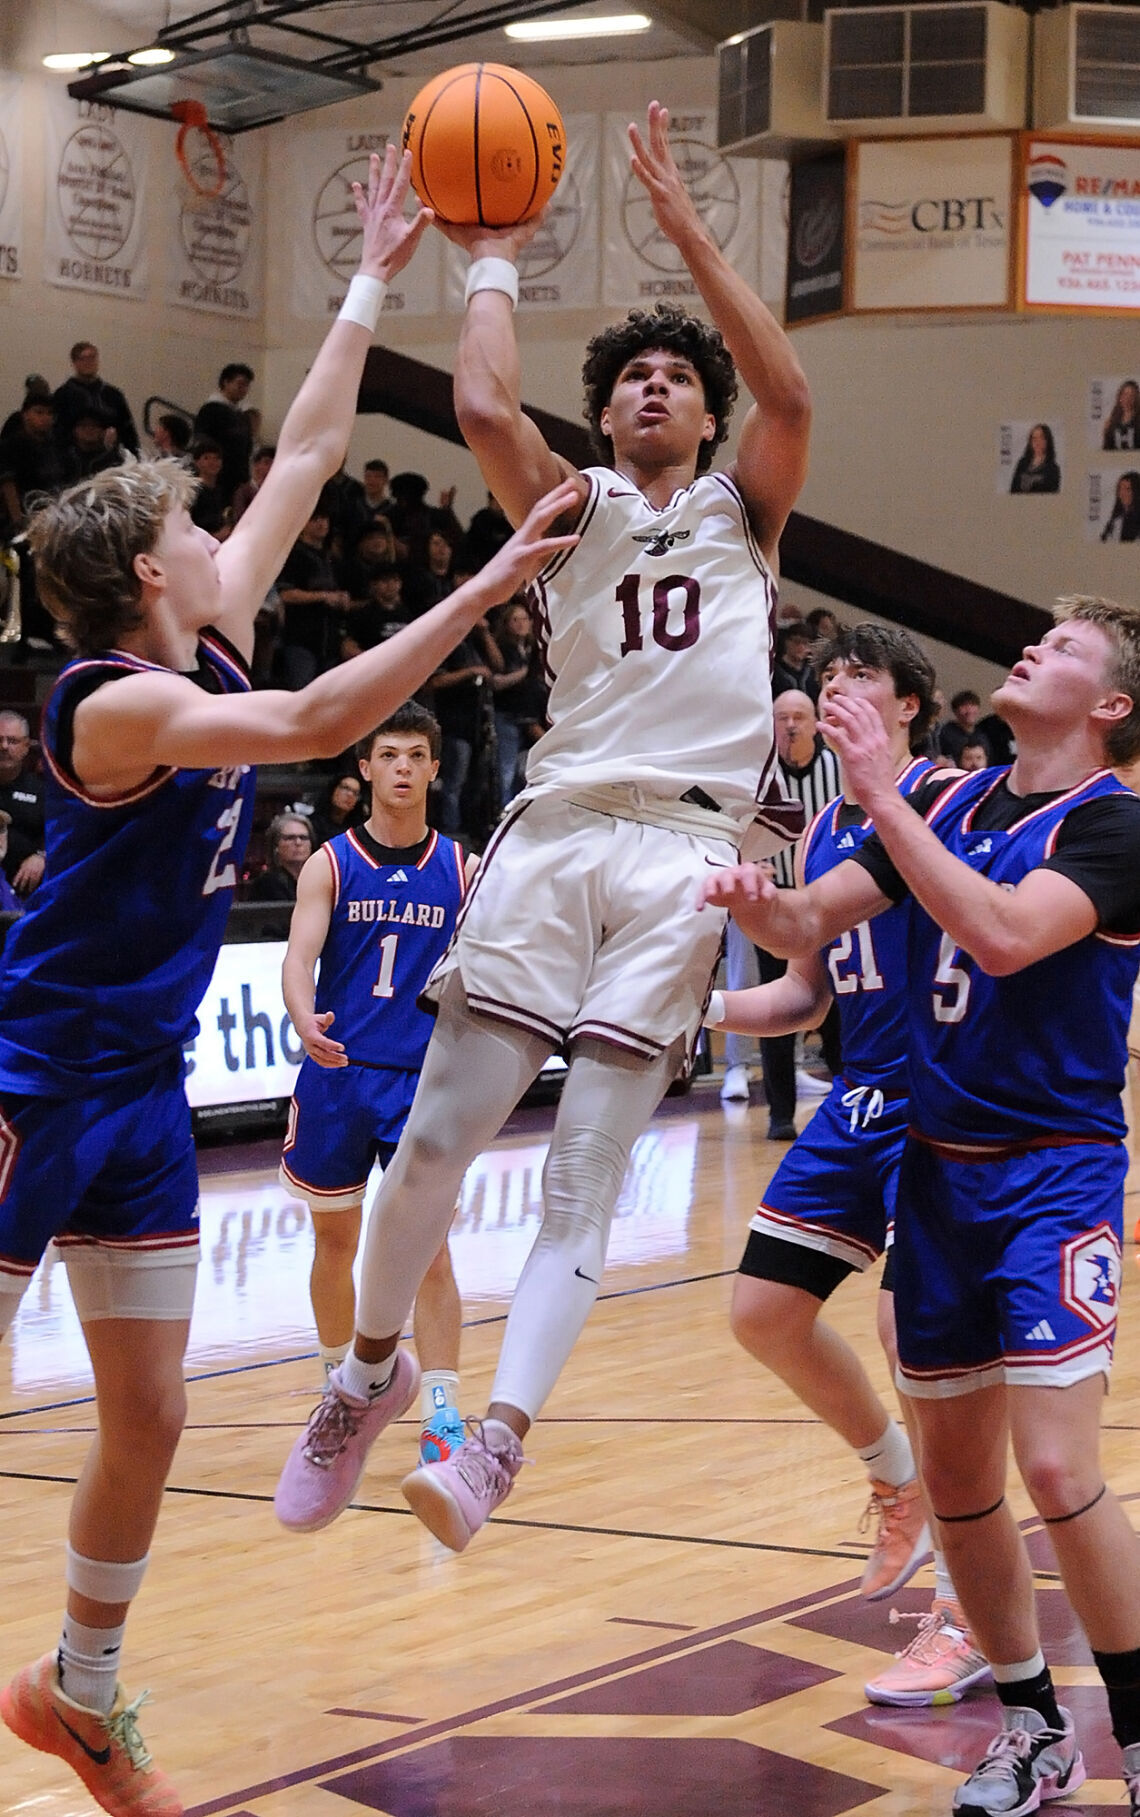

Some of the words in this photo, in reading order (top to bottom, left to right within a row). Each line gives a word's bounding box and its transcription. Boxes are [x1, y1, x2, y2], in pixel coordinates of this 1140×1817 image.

[615, 573, 701, 658] 10
[347, 899, 446, 929] BULLARD
[371, 933, 399, 998] 1
[827, 920, 884, 994] 21
[932, 930, 971, 1023] 5
